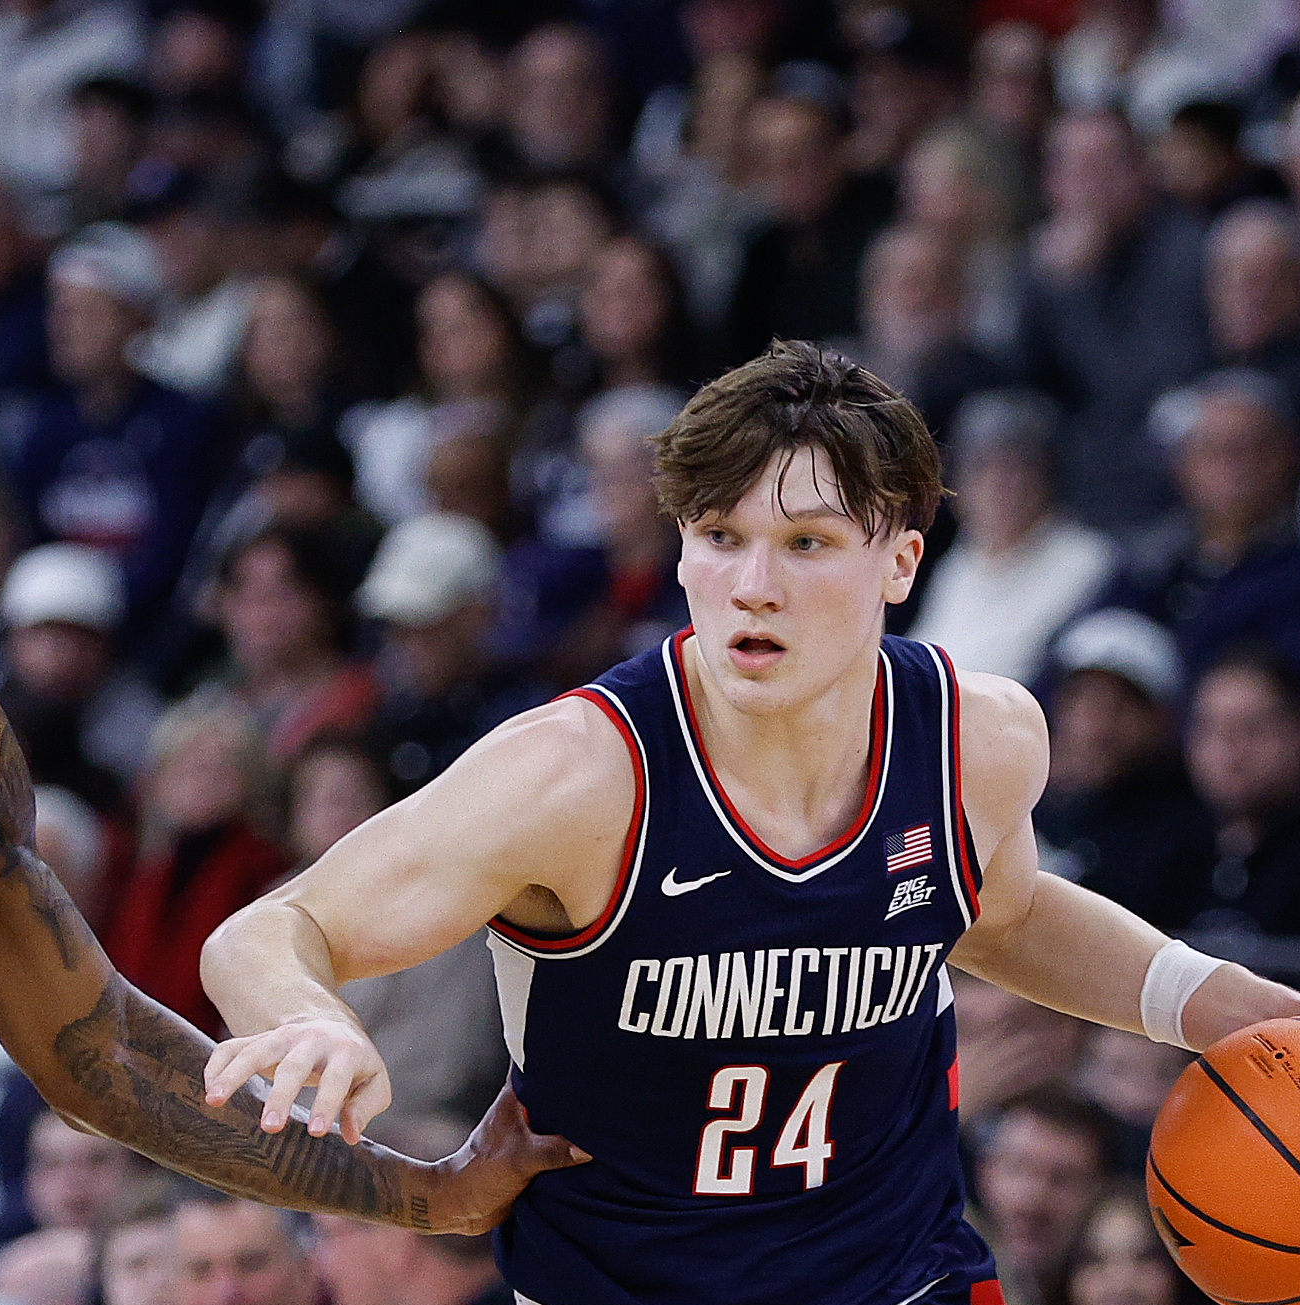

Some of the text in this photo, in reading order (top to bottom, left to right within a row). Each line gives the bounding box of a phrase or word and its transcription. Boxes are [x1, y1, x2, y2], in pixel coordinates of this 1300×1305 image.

[887, 886, 937, 912] EAST
[893, 875, 928, 898] BIG
[617, 943, 944, 1040] CONNECTICUT
[693, 1060, 847, 1195] 24
